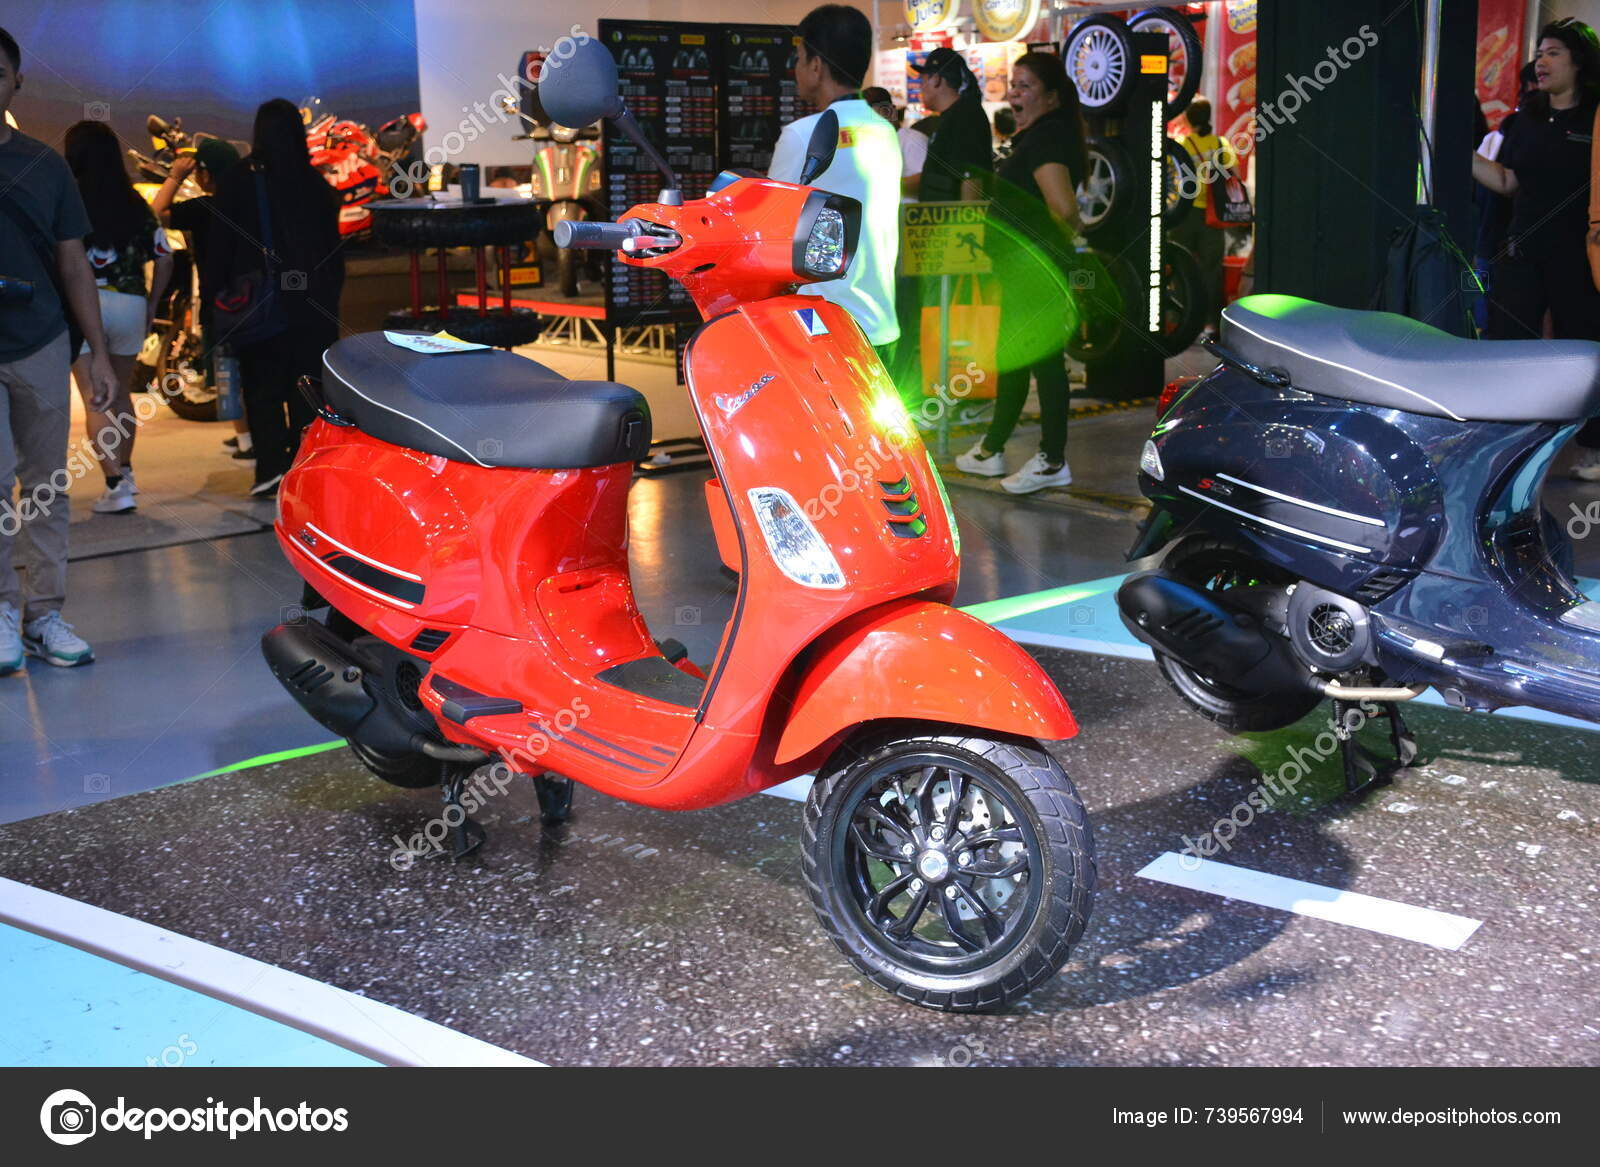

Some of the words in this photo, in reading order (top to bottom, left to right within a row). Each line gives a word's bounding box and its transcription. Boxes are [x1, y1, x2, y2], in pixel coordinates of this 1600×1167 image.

[906, 206, 987, 224] CAUTION
[908, 228, 950, 237] PLEASE
[910, 239, 948, 249] WATCH
[715, 373, 776, 420] Vespa
